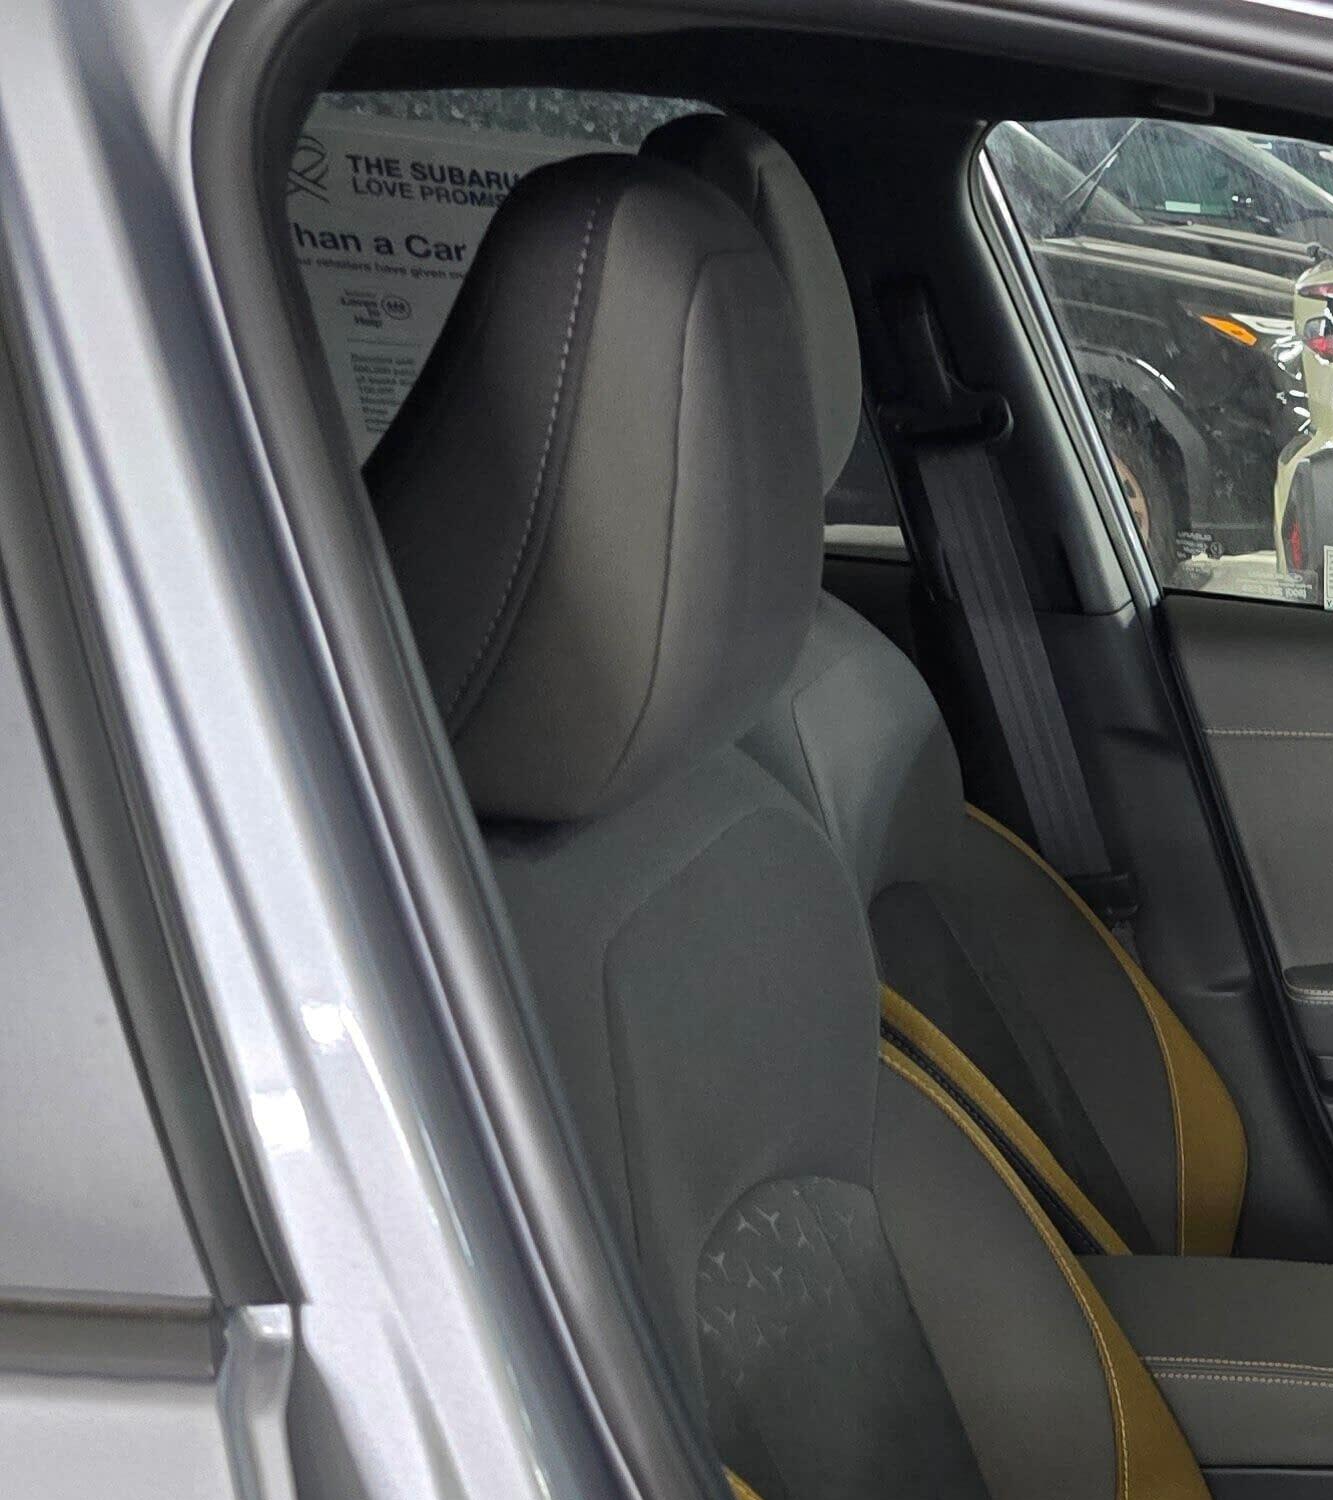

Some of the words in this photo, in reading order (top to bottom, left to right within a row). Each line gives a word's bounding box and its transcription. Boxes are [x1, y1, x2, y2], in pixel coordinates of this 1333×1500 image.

[346, 154, 402, 178] THE
[409, 160, 519, 191] SUBARU
[352, 176, 414, 200] LOVE
[420, 184, 508, 208] PROMIS
[293, 222, 362, 252] han
[374, 236, 394, 256] a
[404, 233, 467, 262] Car
